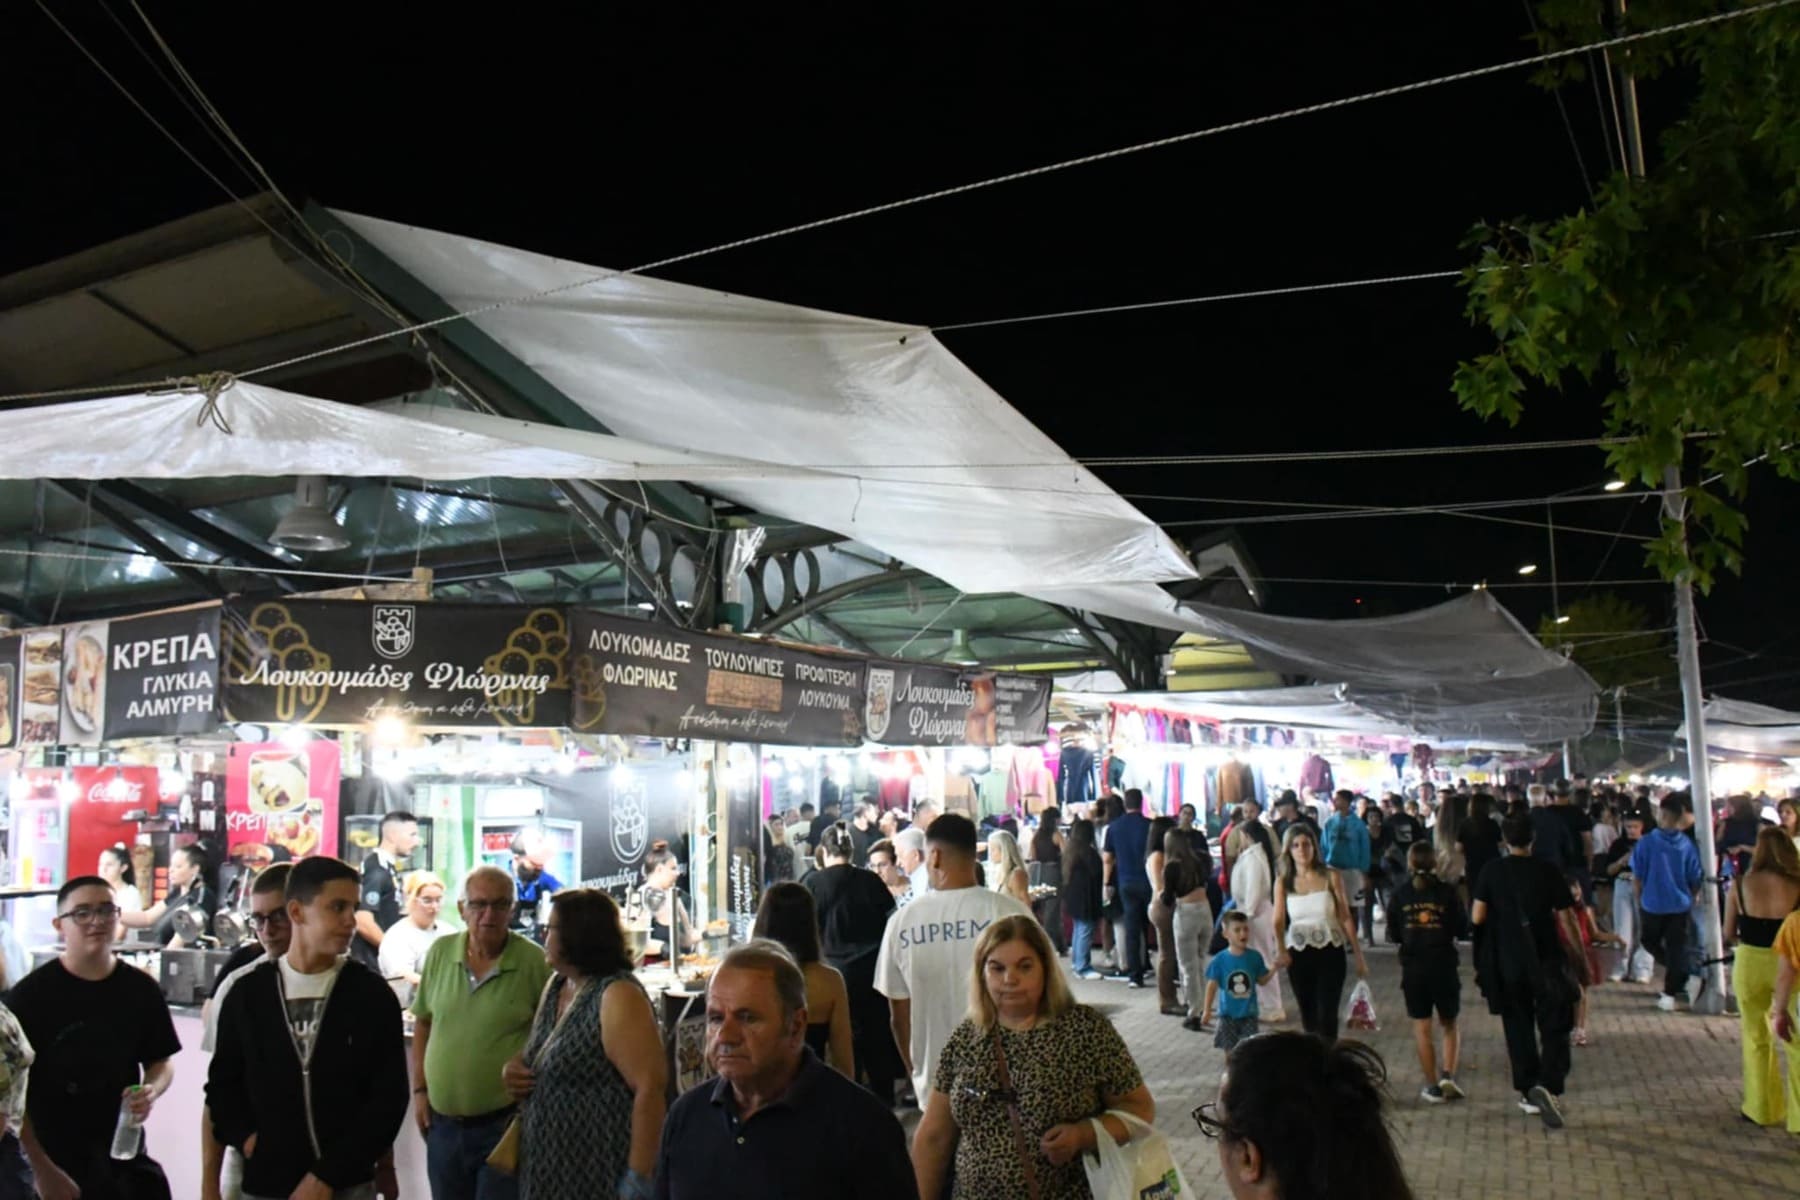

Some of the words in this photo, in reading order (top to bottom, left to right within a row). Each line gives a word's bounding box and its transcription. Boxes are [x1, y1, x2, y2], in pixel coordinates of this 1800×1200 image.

[113, 632, 216, 671] ΚΡΕΠΑ
[588, 629, 691, 663] ΛΟΥΚΟΜΑΔΕΣ
[239, 659, 414, 694] Λουκουμάδες
[424, 662, 551, 697] Φλώρινας
[602, 663, 678, 691] ΦΛΩΡΙΝΑΣ
[705, 648, 784, 678] ΤΟΥΛΟΥΜΠΕΣ
[143, 670, 214, 695] ΓΛΥΚΙΑ
[126, 694, 214, 719] ΑΛΜΥΡΗ
